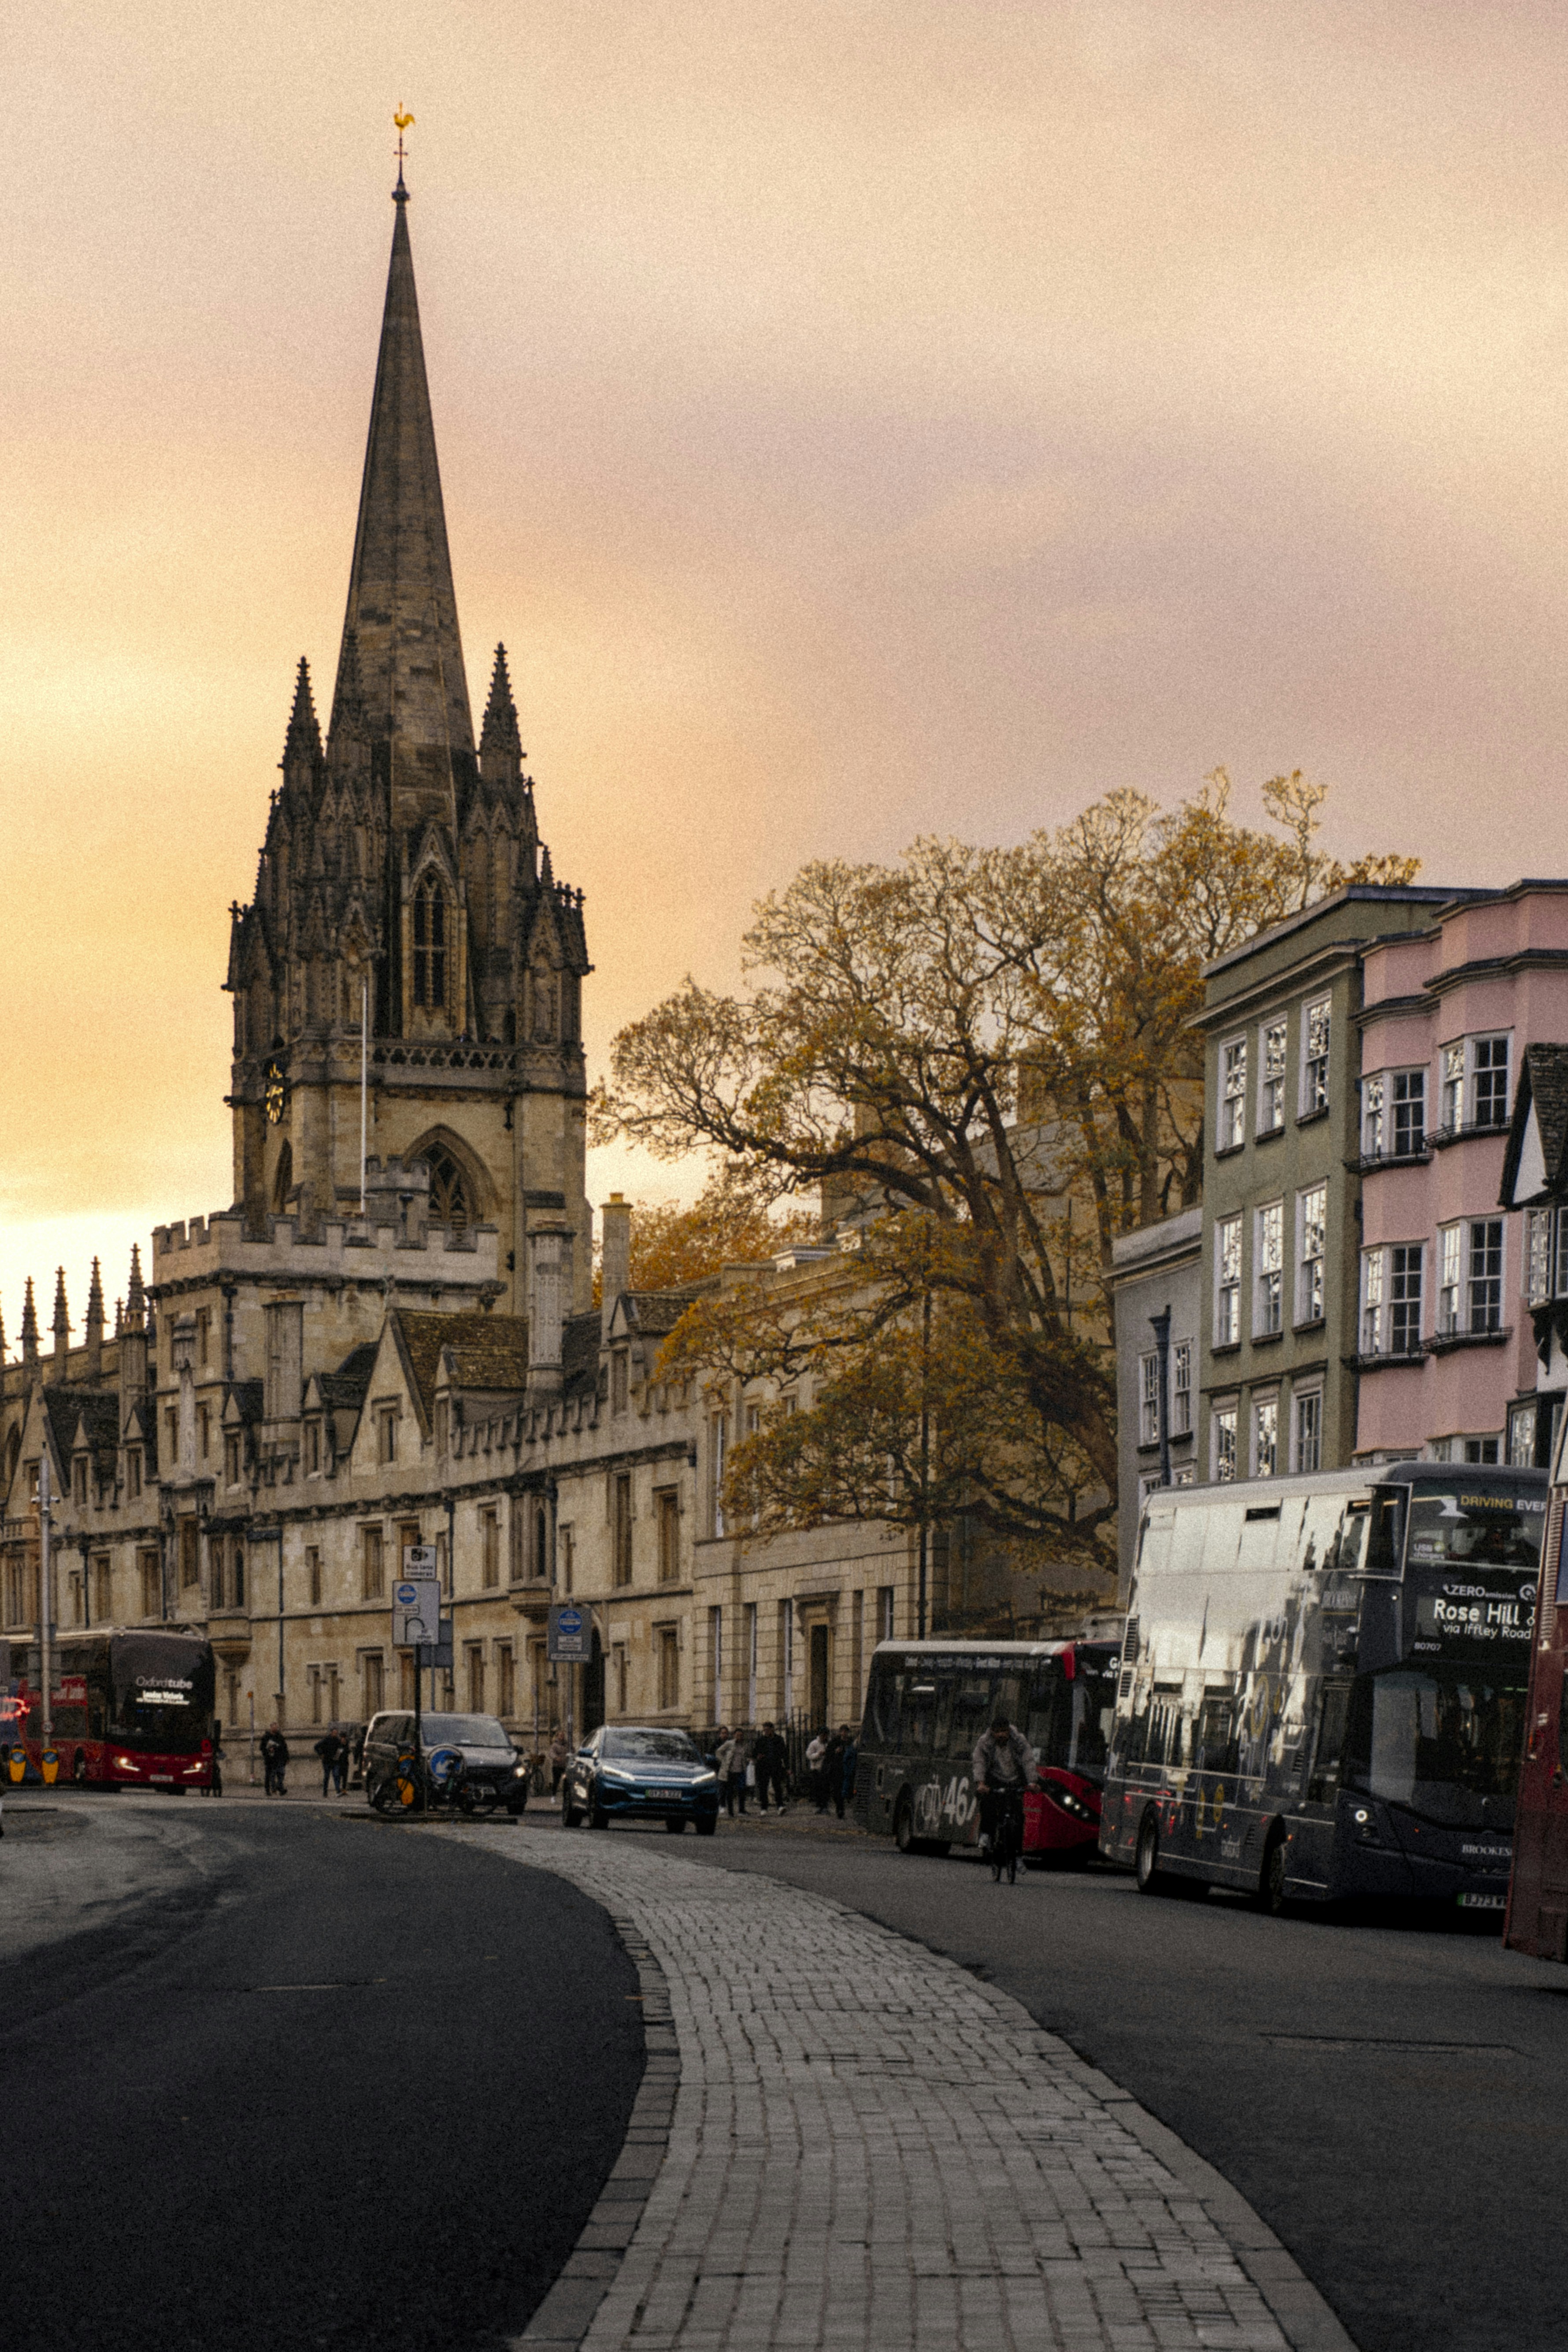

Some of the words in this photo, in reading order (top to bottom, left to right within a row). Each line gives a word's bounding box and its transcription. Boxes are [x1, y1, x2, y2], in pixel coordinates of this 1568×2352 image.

[1461, 1495, 1513, 1510] DRIVING
[1450, 1584, 1485, 1598] ZERO
[1485, 1591, 1516, 1600] emission
[1434, 1599, 1480, 1622] Rose
[1486, 1603, 1520, 1625] Hill
[1443, 1623, 1461, 1634] via
[1464, 1623, 1499, 1640] Iffley
[1501, 1625, 1532, 1639] Road
[1413, 1641, 1442, 1651] 80707
[1461, 1844, 1512, 1856] BROOKES
